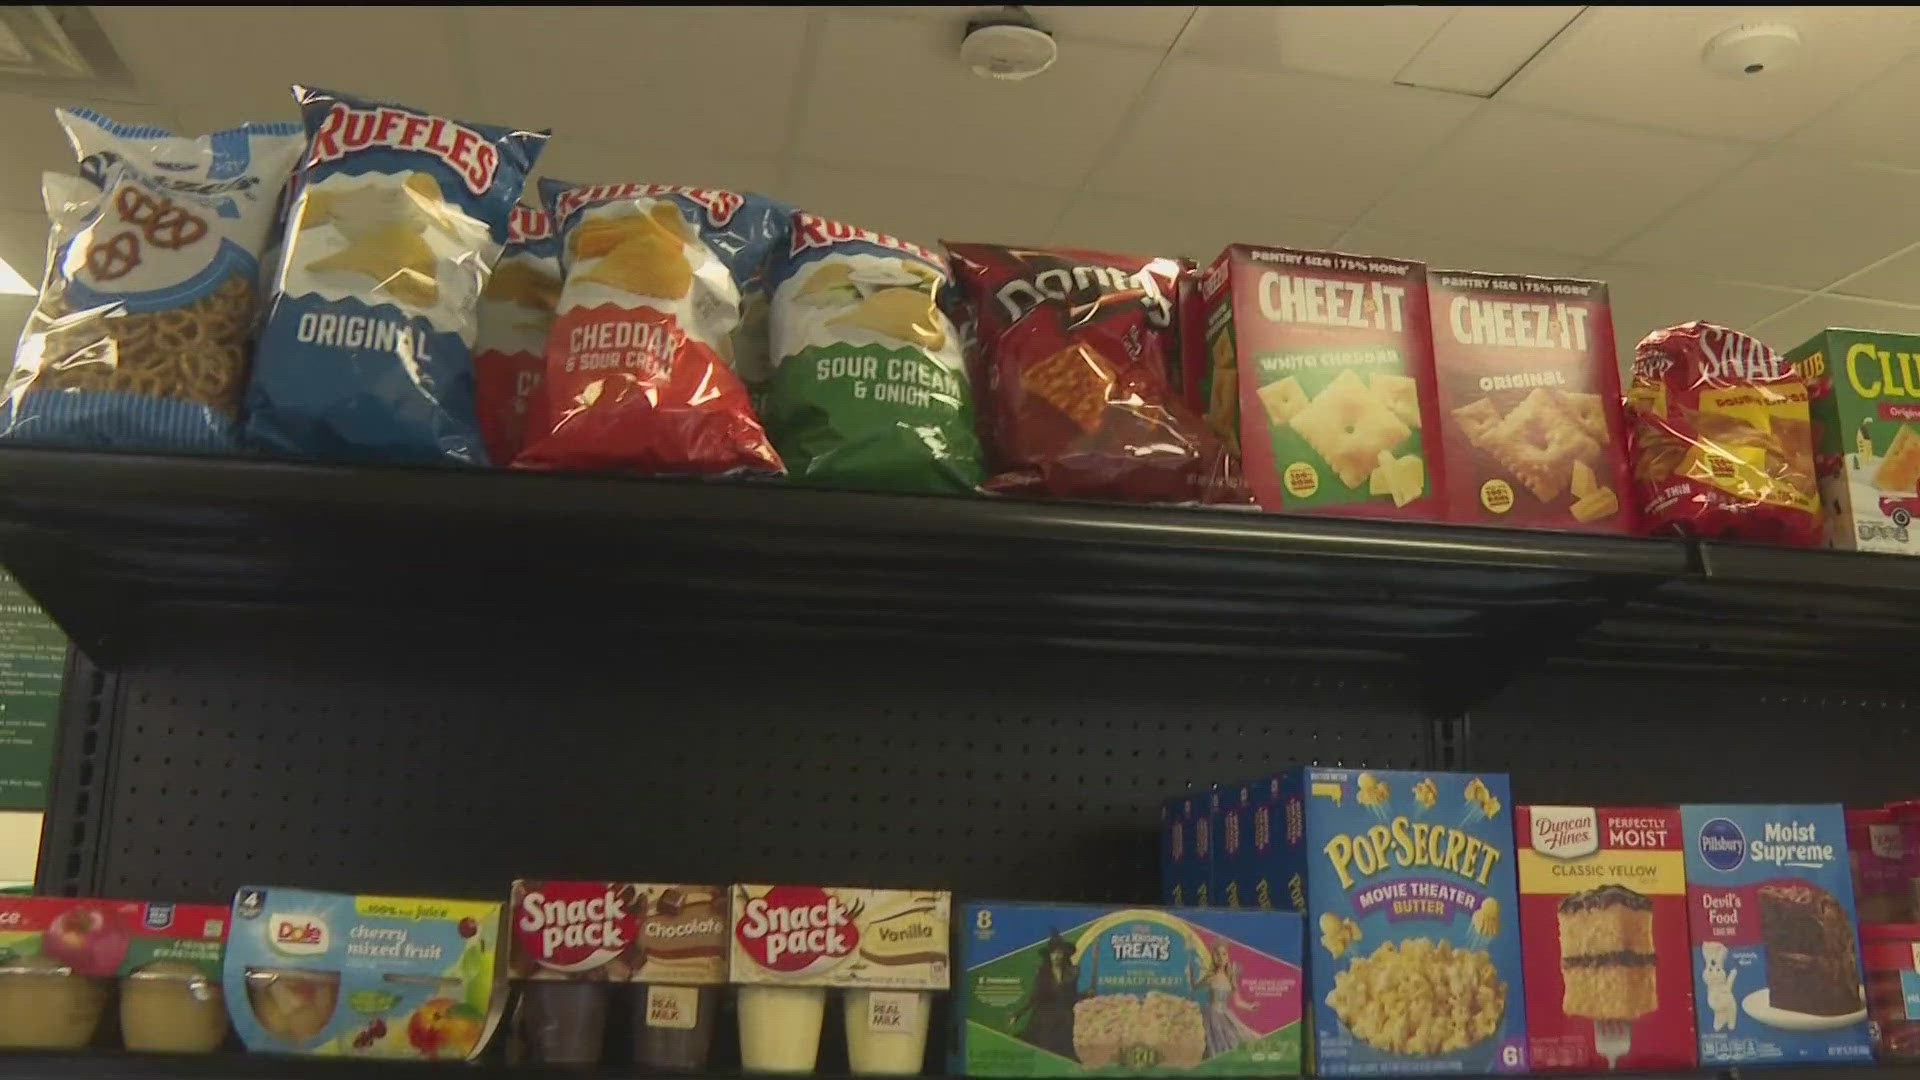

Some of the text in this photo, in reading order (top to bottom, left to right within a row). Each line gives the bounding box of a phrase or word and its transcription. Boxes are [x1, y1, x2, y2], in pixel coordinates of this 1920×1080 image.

[307, 101, 500, 195] RUFFLES
[298, 312, 433, 363] ORIGINAL
[570, 322, 678, 362] CHEDDAR
[580, 351, 621, 371] SOUR
[816, 356, 962, 399] SOUR CREAM
[854, 380, 931, 409] & ONION
[1535, 816, 1592, 836] Duncan
[1608, 817, 1666, 830] PERFECTLY
[1764, 820, 1816, 843] Moist
[1544, 830, 1592, 853] Hines
[1609, 829, 1669, 848] MOIST
[1701, 835, 1744, 854] Pillsbury
[1750, 841, 1834, 863] Supreme
[1552, 864, 1657, 877] CLASSIC YELLOW
[244, 892, 258, 907] 4
[1359, 882, 1476, 908] MOVIE THEATER
[1702, 893, 1742, 909] Devil's
[415, 904, 448, 920] juice
[519, 891, 627, 932] Snack
[1393, 900, 1445, 915] BUTTER
[1709, 909, 1739, 924] Food
[742, 896, 851, 939] Snack
[976, 909, 993, 929] 8
[278, 922, 322, 941] Dole
[350, 924, 408, 943] cherry
[542, 920, 625, 958] pack
[645, 920, 725, 939] Chocolate
[878, 922, 934, 943] Vanilla
[347, 943, 441, 960] mixed fruit
[766, 928, 848, 965] pack
[1112, 943, 1171, 961] TREATS
[652, 999, 679, 1009] REAL
[873, 1003, 900, 1014] REAL
[651, 1009, 679, 1021] MILK
[872, 1014, 901, 1026] MILK
[1503, 1046, 1518, 1066] 6
